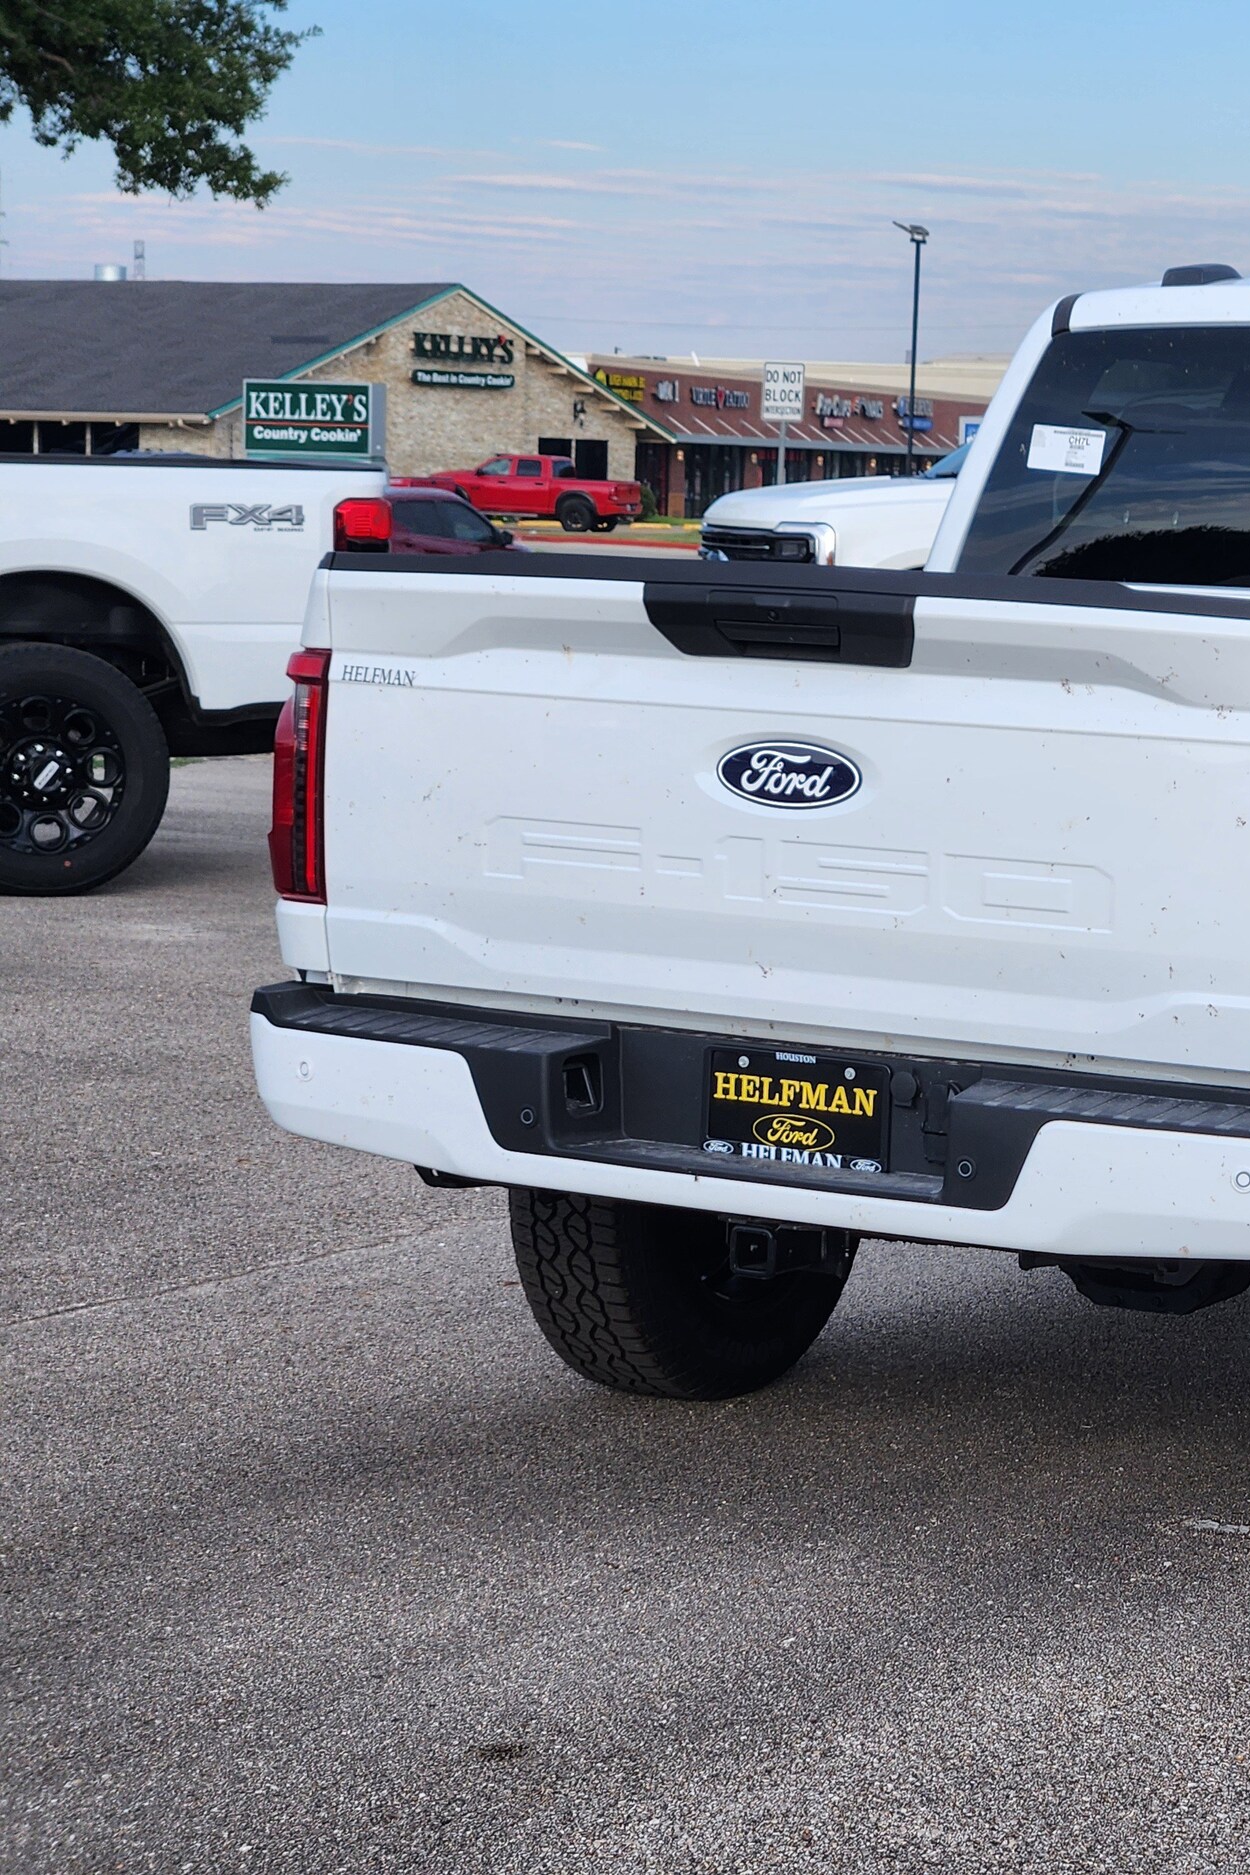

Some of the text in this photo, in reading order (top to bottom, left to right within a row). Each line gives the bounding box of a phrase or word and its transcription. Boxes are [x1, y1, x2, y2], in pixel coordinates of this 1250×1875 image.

[413, 332, 515, 364] KELLEY'S
[417, 371, 431, 382] The
[432, 372, 449, 383] Best
[458, 374, 485, 387] Country
[766, 370, 802, 384] DO NOT
[249, 391, 367, 422] KELLEY'S
[765, 388, 801, 402] BLOCK
[253, 426, 362, 443] Country Cookin'
[1068, 436, 1091, 446] CH7L
[189, 503, 305, 530] FX4
[341, 664, 418, 687] HELFMAN
[740, 749, 832, 798] Ford
[775, 1051, 817, 1065] HOUSTON
[713, 1071, 878, 1117] HELFMAN
[766, 1116, 819, 1147] Ford
[741, 1142, 843, 1169] HELFMAN
